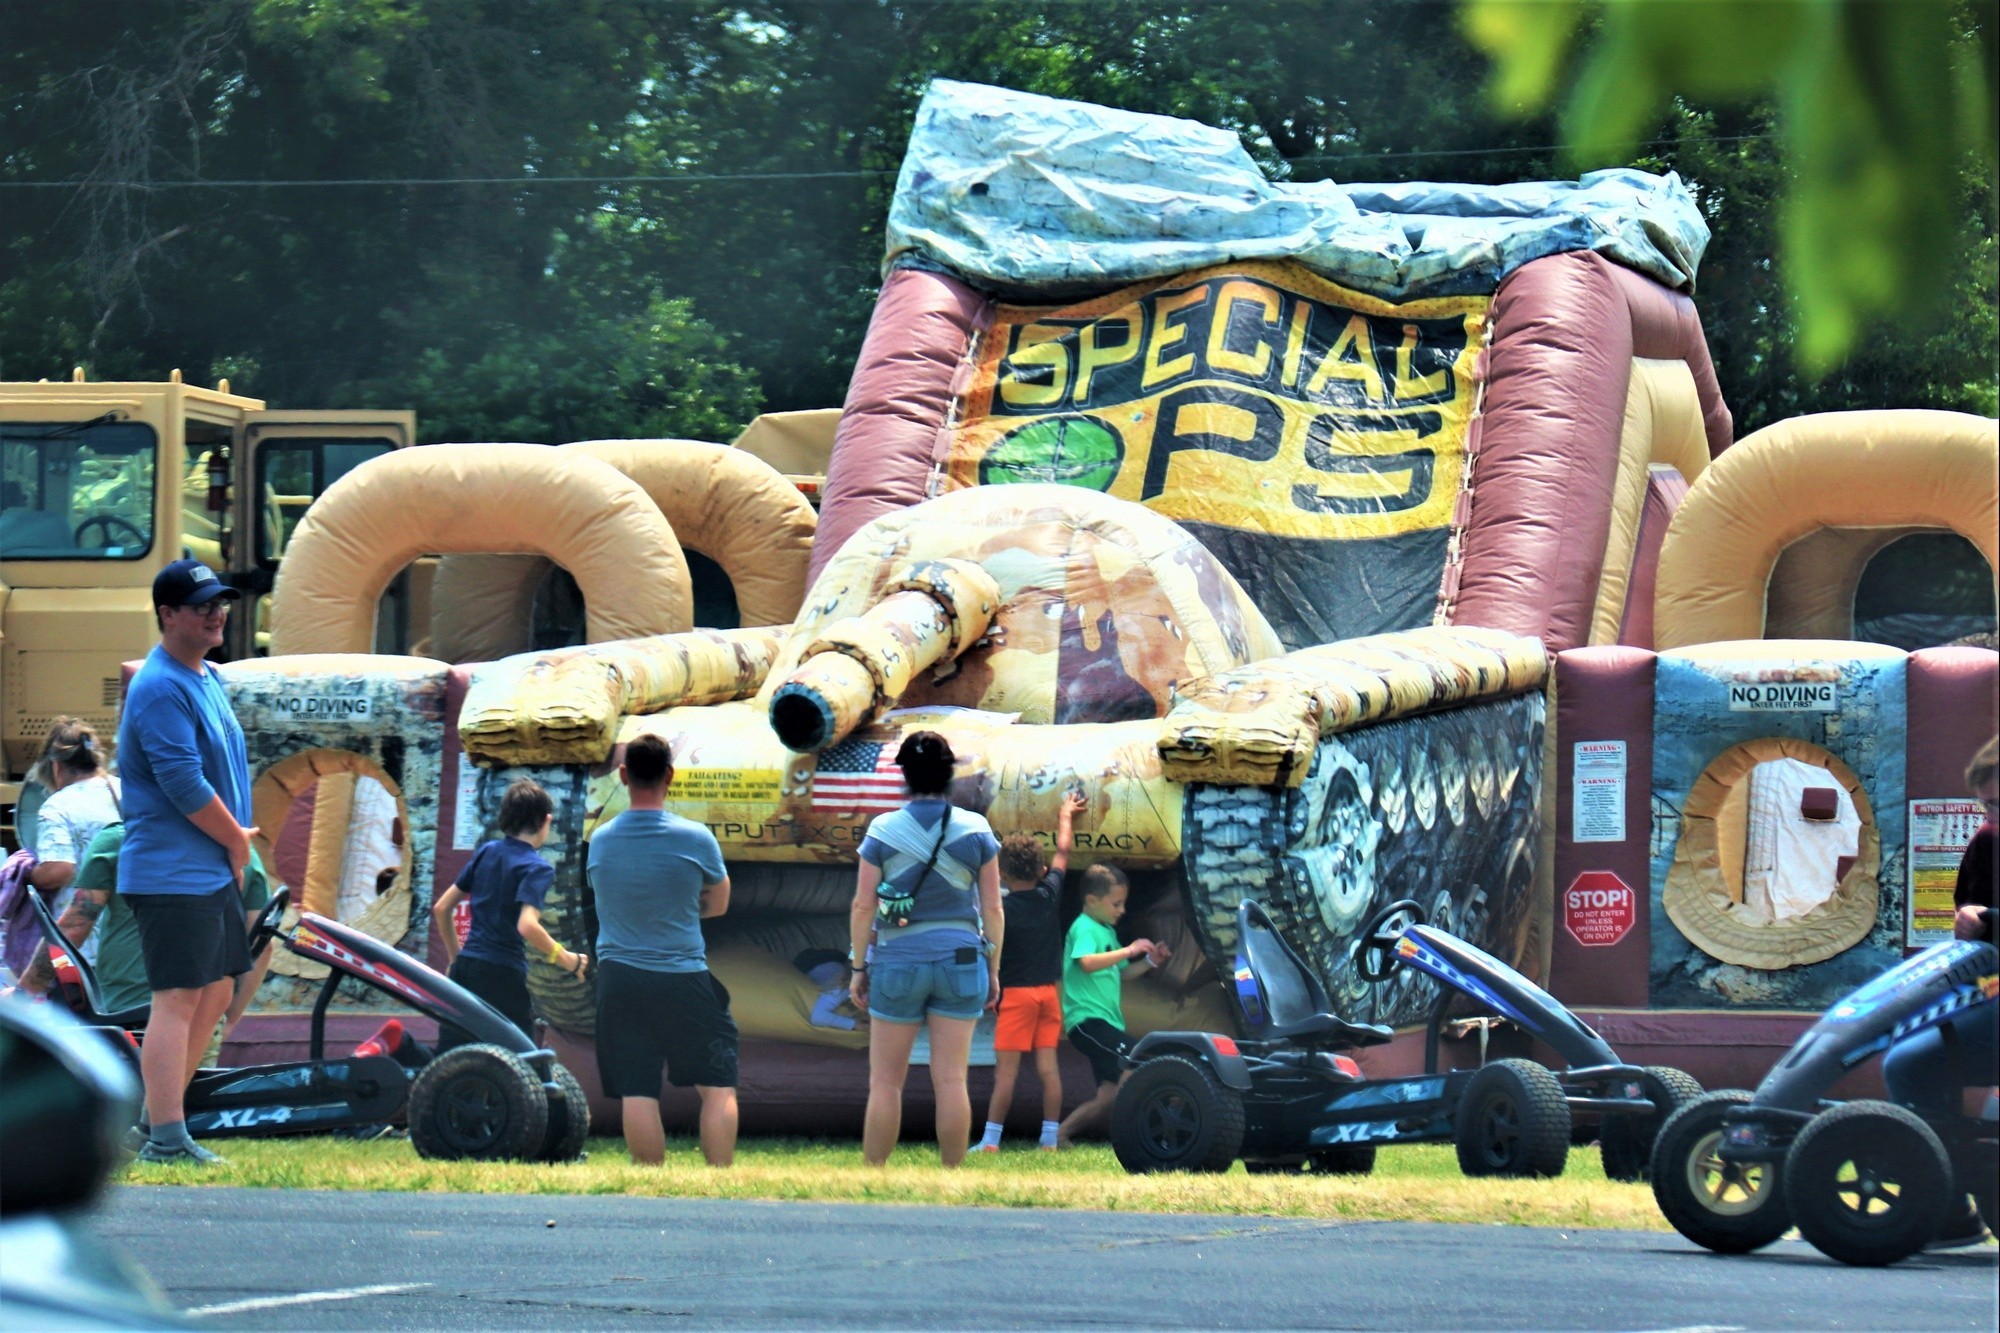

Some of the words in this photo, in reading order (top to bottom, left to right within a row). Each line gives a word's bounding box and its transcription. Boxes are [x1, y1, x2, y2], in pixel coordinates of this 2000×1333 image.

[1000, 280, 1450, 405] SPECIAL
[978, 387, 1444, 514] OPS
[1732, 687, 1760, 702] NO
[1766, 686, 1831, 702] DIVING
[275, 698, 300, 712] NO
[306, 698, 367, 713] DIVING
[1775, 701, 1791, 709] FEET
[1582, 744, 1617, 752] WARNING
[1920, 805, 1944, 813] PATRON
[1945, 804, 1970, 813] SAFETY
[708, 823, 782, 840] TPUT
[1568, 889, 1629, 909] STOP!
[1576, 925, 1614, 933] OPERATOR
[207, 1106, 292, 1130] XL-4
[1328, 1121, 1399, 1144] XL-4
